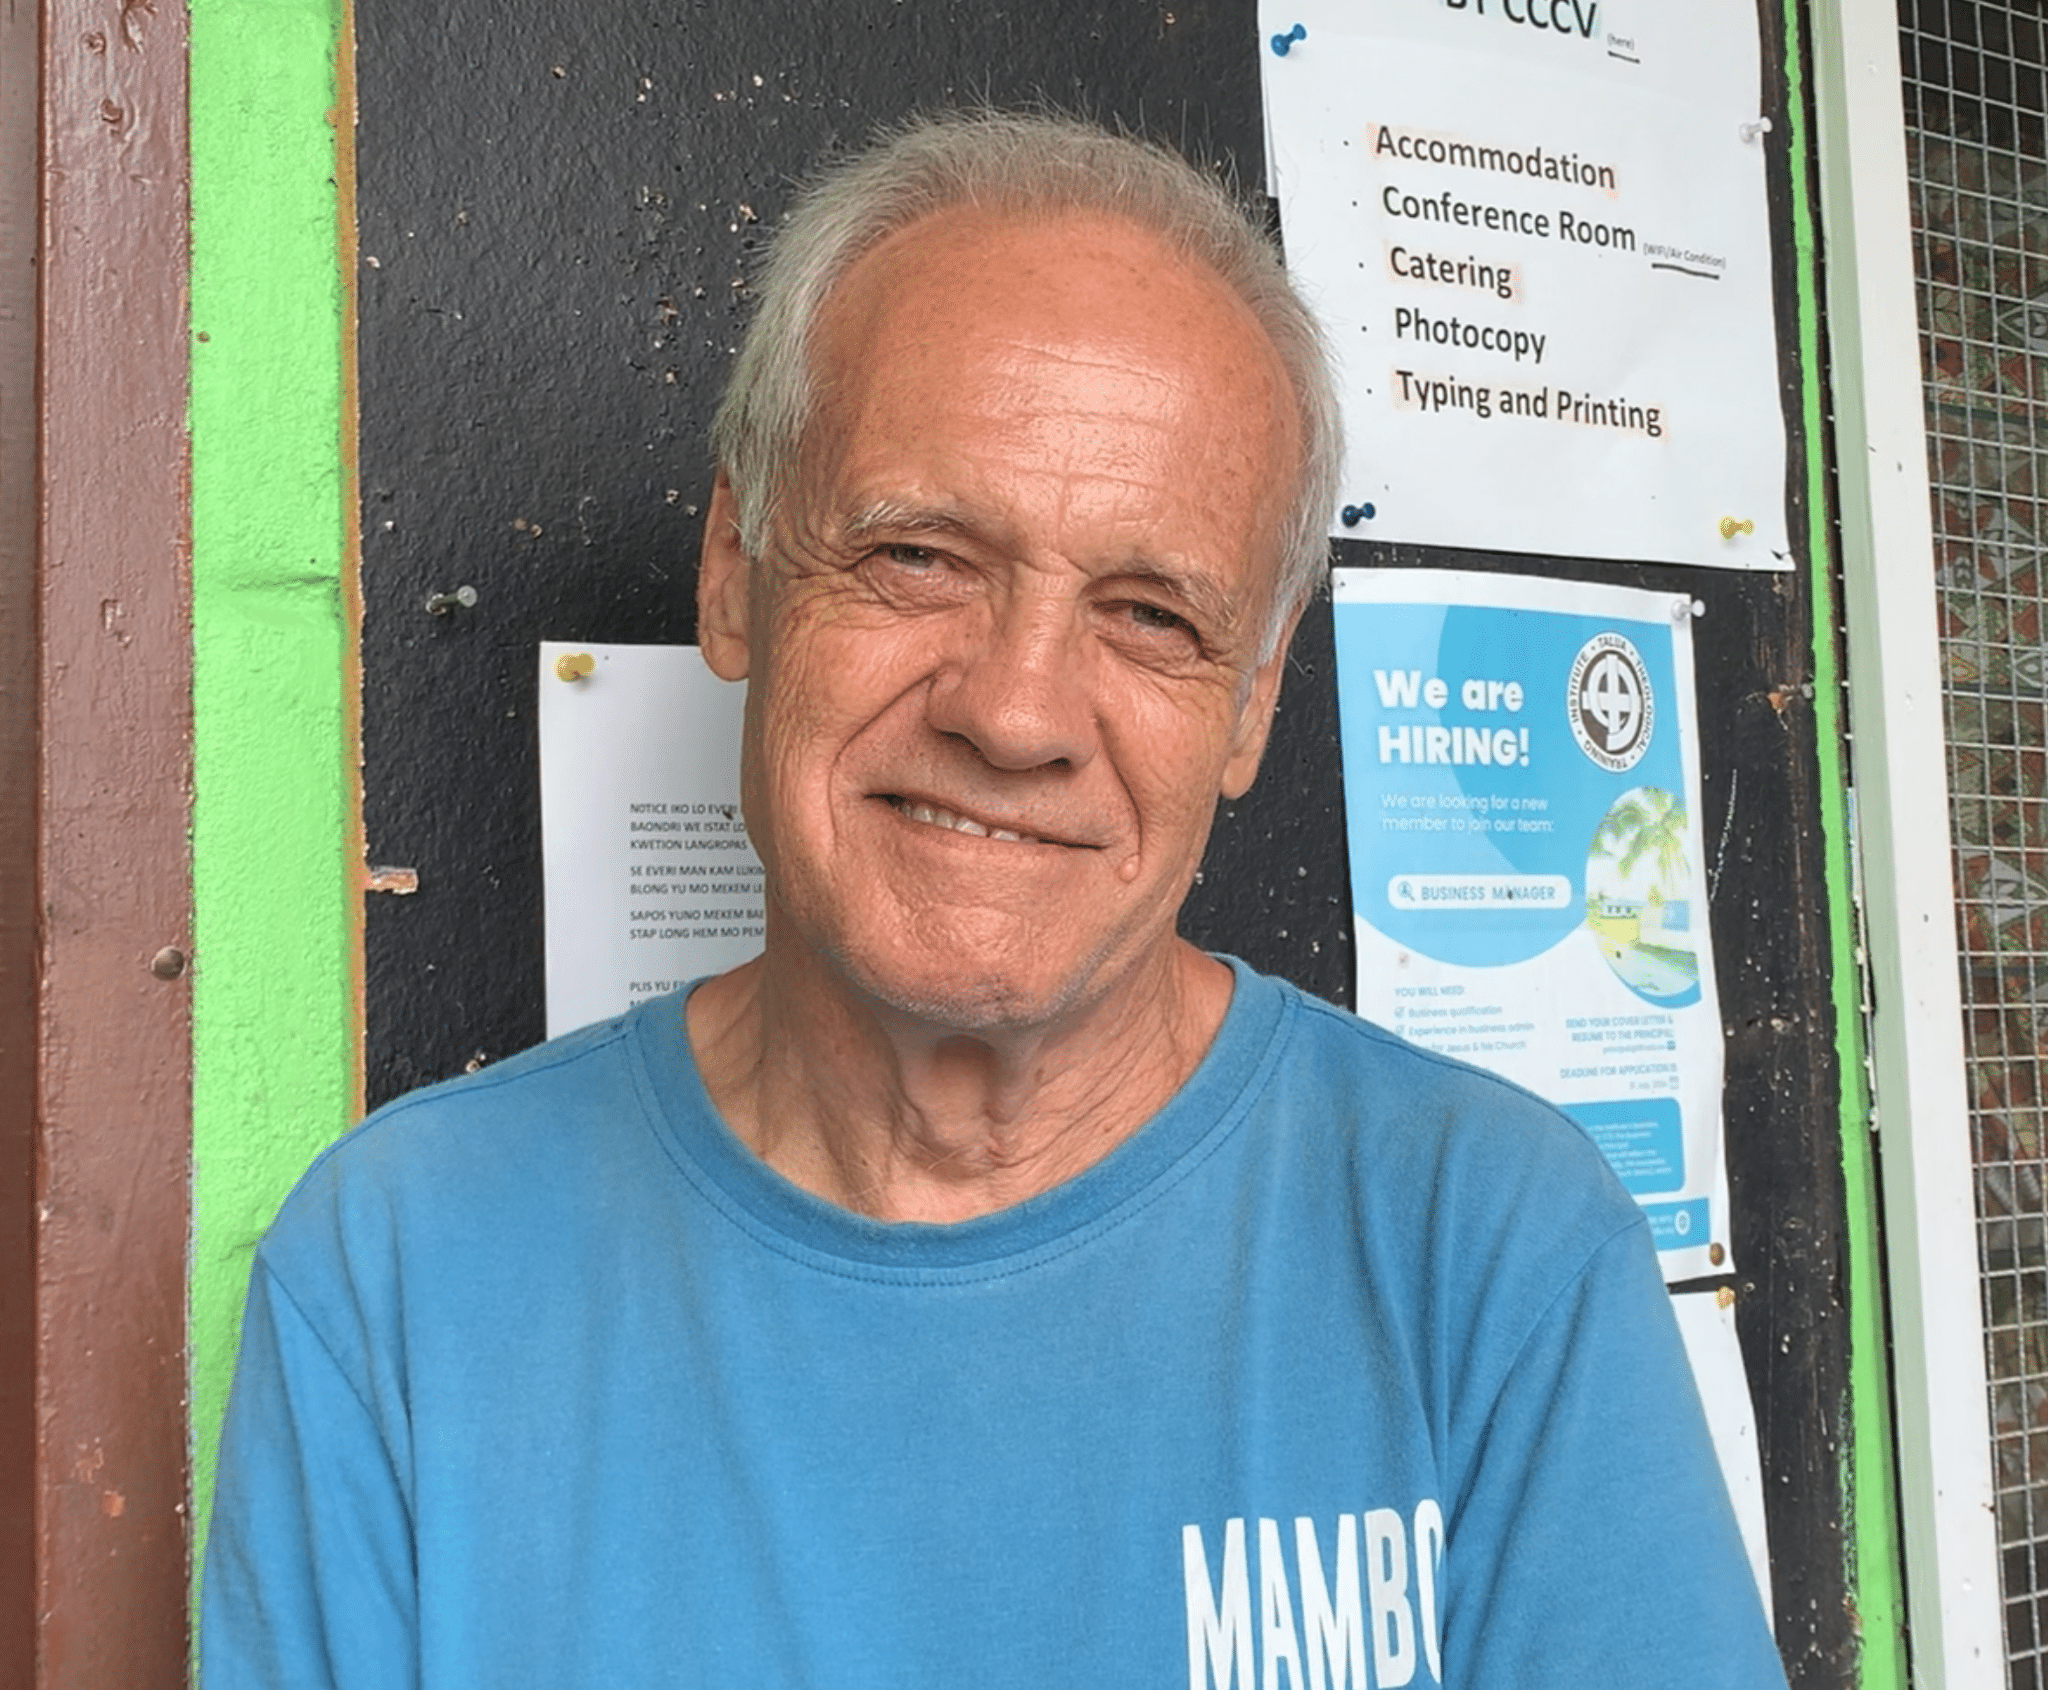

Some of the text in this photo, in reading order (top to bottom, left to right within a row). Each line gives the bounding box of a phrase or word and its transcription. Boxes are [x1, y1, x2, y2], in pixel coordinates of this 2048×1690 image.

[1503, 0, 1596, 38] CCCV
[1375, 126, 1616, 190] Accommodation
[1382, 186, 1551, 237] Conference
[1558, 211, 1637, 251] Room
[1390, 247, 1512, 299] Catering
[1394, 308, 1546, 364] Photocopy
[1396, 370, 1662, 437] Typing and Printing
[1374, 669, 1524, 712] We are
[1570, 651, 1590, 723] INSTITUTE
[1378, 726, 1530, 767] HIRING!
[630, 803, 667, 814] NOTICE
[691, 803, 706, 815] LO
[1380, 794, 1548, 815] We are looking for a new
[683, 821, 701, 832] WE
[703, 821, 731, 832] ISTAT
[1382, 817, 1447, 832] member
[1451, 818, 1466, 832] to
[1467, 818, 1491, 836] join
[1494, 819, 1516, 832] our
[630, 866, 642, 876] SE
[646, 865, 677, 876] EVERI
[679, 865, 707, 876] MAN
[709, 865, 735, 876] KAM
[630, 883, 668, 894] BLONG
[670, 883, 686, 894] YU
[688, 883, 709, 894] MO
[711, 883, 750, 894] MEKEM
[1421, 886, 1556, 901] BUSINESS MANAGER
[630, 909, 667, 921] SAPOS
[703, 909, 744, 920] MEKEM
[630, 928, 657, 938] STAP
[659, 927, 690, 938] LONG
[692, 927, 718, 938] HEM
[720, 926, 739, 937] MO
[655, 981, 671, 991] YU
[1394, 987, 1417, 997] YOU
[1418, 986, 1438, 996] WILL
[1408, 1005, 1503, 1018] Business qualification
[1408, 1026, 1457, 1037] Experience
[1468, 1024, 1506, 1034] business
[1182, 1499, 1443, 1690] MAMBO
